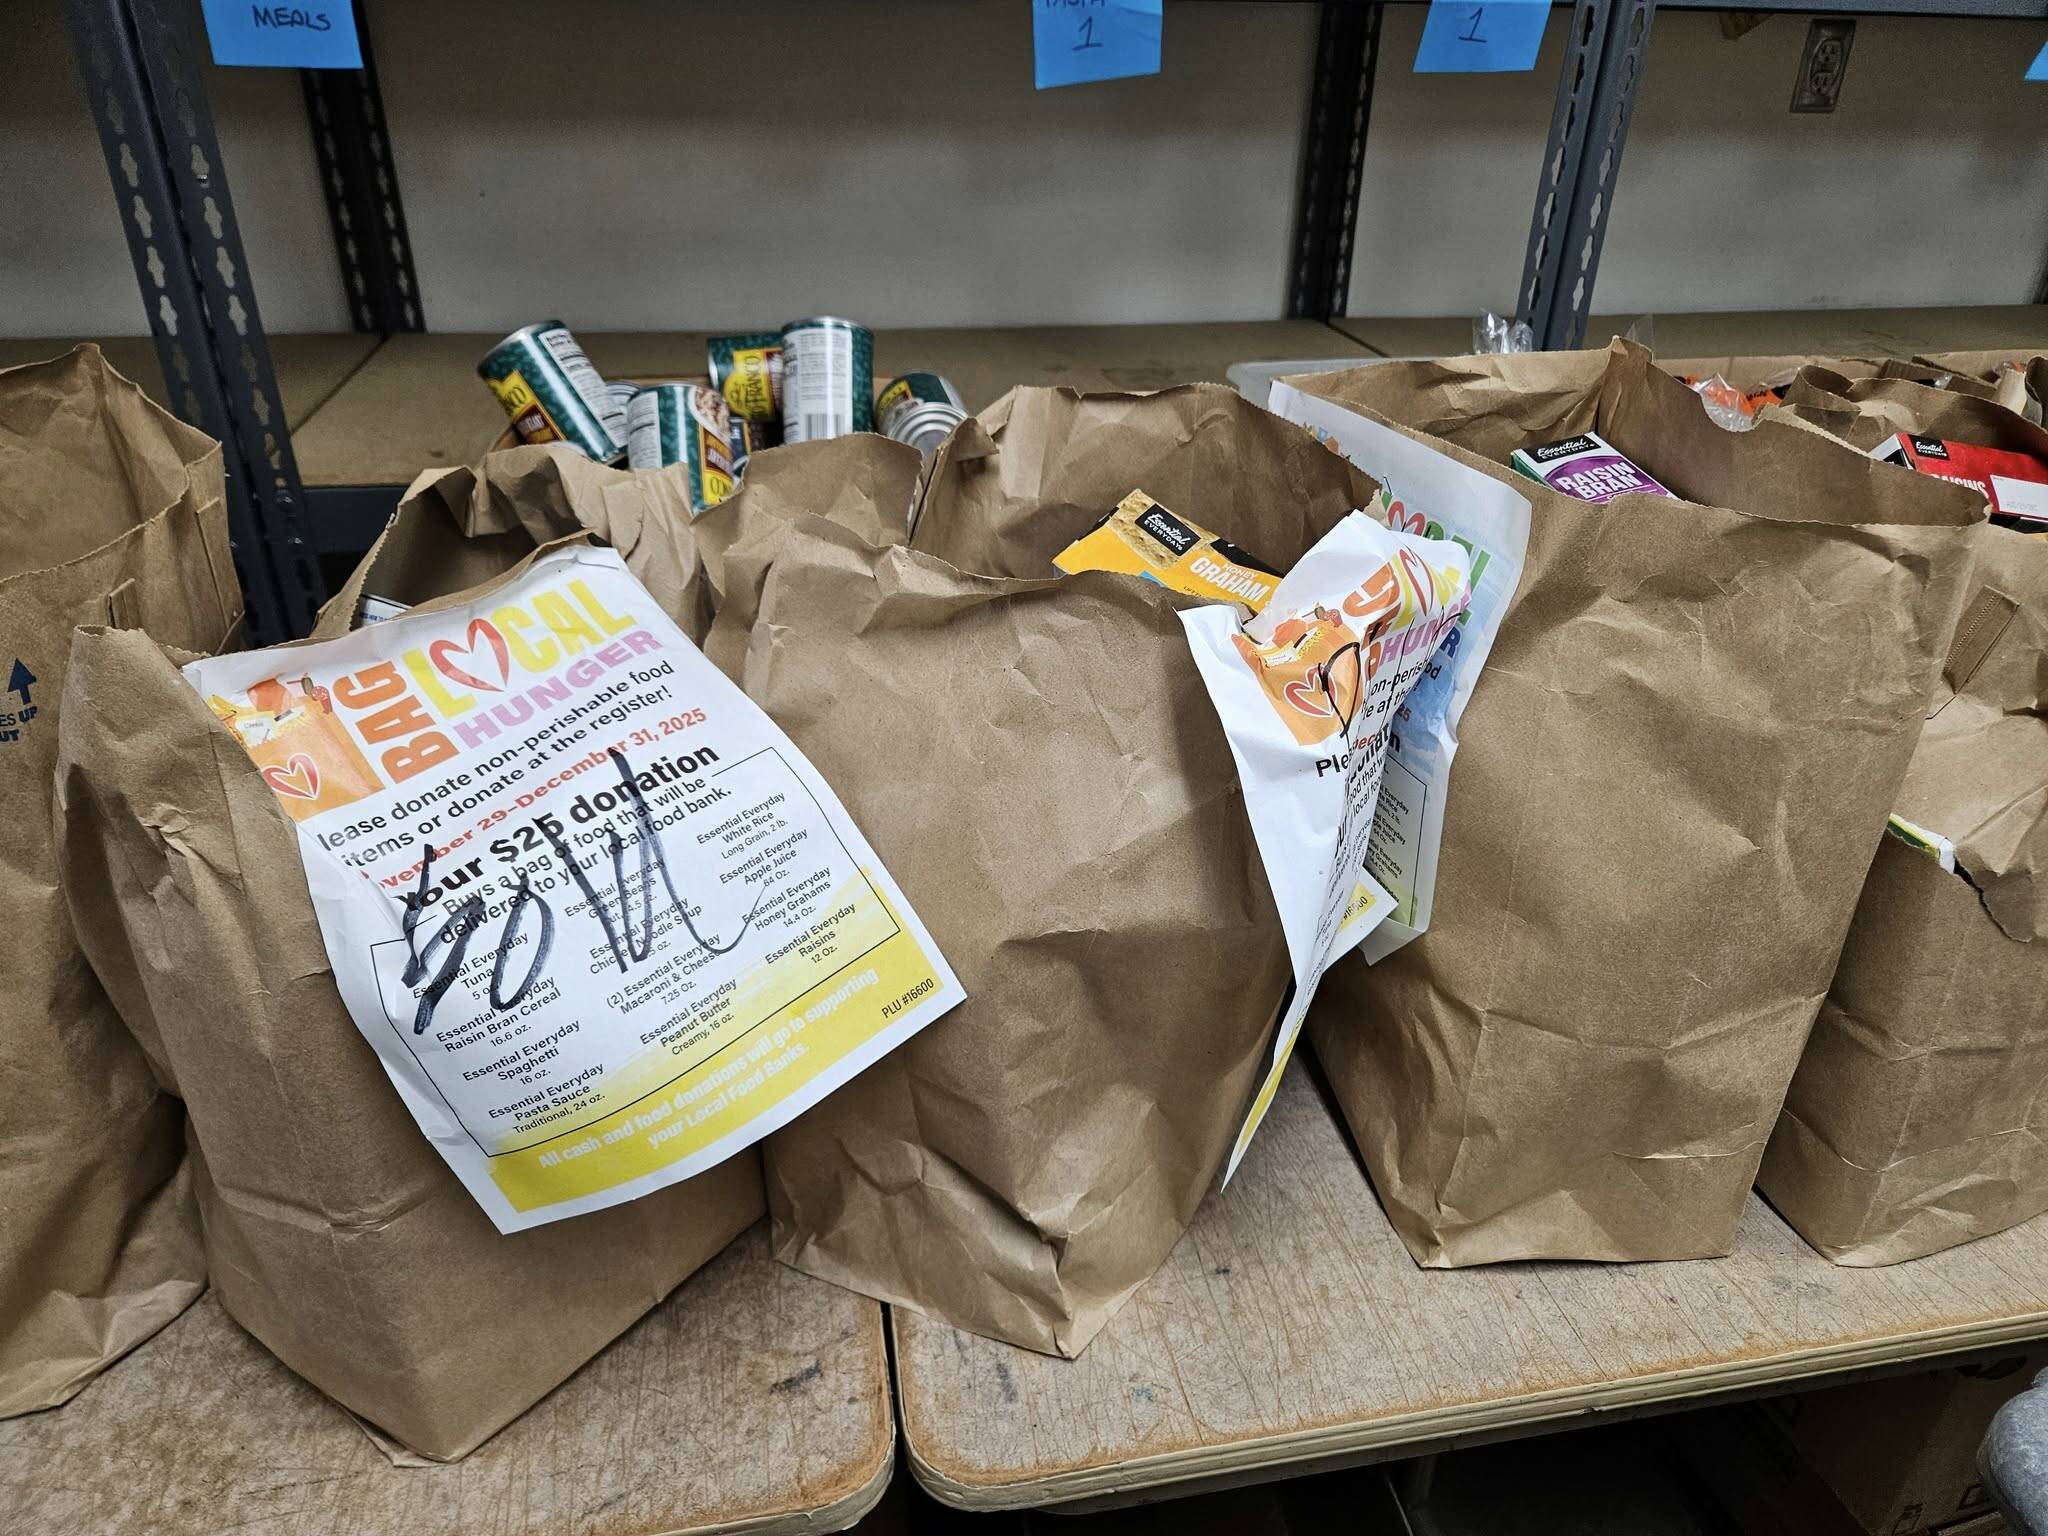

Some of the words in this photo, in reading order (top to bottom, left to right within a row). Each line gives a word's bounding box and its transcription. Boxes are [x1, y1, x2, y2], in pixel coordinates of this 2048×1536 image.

[252, 5, 331, 31] MEALS
[1072, 16, 1104, 51] 1
[1458, 7, 1487, 43] 1
[1537, 438, 1588, 457] Essential
[1915, 441, 1944, 453] Essential
[1555, 461, 1636, 491] RAISIN
[1575, 473, 1643, 499] BRAN
[1143, 519, 1183, 551] EVERYDAY
[1147, 513, 1192, 546] Essential
[1188, 557, 1272, 602] GRAHAM
[1221, 562, 1259, 580] HONEY
[453, 630, 663, 749] HUNGER
[18, 705, 37, 722] UP
[332, 660, 460, 784] BAG
[629, 728, 660, 746] 31,
[658, 707, 707, 736] 2025
[316, 815, 387, 851] lease
[391, 773, 472, 820] donate
[474, 680, 630, 777] non-perishable
[629, 660, 675, 685] food
[341, 832, 415, 867] items
[418, 815, 442, 835] or
[447, 769, 525, 818] donate
[527, 751, 551, 770] at
[551, 729, 587, 753] the
[589, 685, 673, 730] register!
[490, 812, 565, 863] $25
[569, 746, 720, 823] donation
[696, 814, 742, 844] Essential
[741, 791, 786, 820] Everyday
[442, 883, 495, 916] Buys
[498, 875, 510, 888] a
[511, 854, 552, 880] bag
[554, 839, 573, 859] of
[573, 818, 616, 848] food
[616, 800, 654, 825] that
[652, 784, 684, 807] will
[684, 777, 706, 793] be
[721, 823, 751, 844] White
[751, 811, 774, 827] Rice
[721, 843, 745, 860] Long
[744, 827, 771, 847] Grain,
[769, 823, 777, 832] 2
[776, 818, 789, 828] lb.
[440, 886, 532, 944] delivered
[534, 876, 555, 893] to
[557, 852, 598, 885] your
[600, 827, 646, 855] local
[646, 806, 685, 835] food
[684, 786, 732, 814] bank.
[719, 852, 764, 884] Essential
[764, 827, 809, 859] Everyday
[743, 863, 772, 885] Apple
[772, 849, 798, 868] Juice
[564, 883, 616, 918] Essential
[618, 858, 665, 888] veryday
[741, 890, 786, 924] Essential
[785, 866, 832, 898] Everyday
[763, 876, 775, 887] 64
[775, 869, 791, 880] Oz.
[589, 895, 622, 919] Geen
[640, 898, 689, 928] Eeryday
[674, 905, 702, 925] Soup
[753, 908, 787, 931] Honey
[786, 880, 832, 911] Grahams
[782, 914, 801, 928] 14.4
[801, 906, 817, 918] Oz.
[471, 932, 529, 969] Everyday
[764, 931, 810, 965] Essential
[809, 902, 857, 935] Everyday
[798, 930, 837, 958] Raisins
[606, 991, 624, 1008] (2)
[623, 960, 674, 996] Essential
[673, 933, 721, 966] Everyday
[810, 954, 823, 964] 12
[821, 945, 838, 958] Oz.
[461, 968, 495, 990] Tuna
[472, 991, 481, 1001] 5
[619, 977, 671, 1015] Macaroni
[671, 972, 682, 983] &
[682, 951, 721, 976] Cheese
[660, 989, 681, 1006] 7.25
[681, 981, 697, 992] Oz.
[881, 1003, 902, 1019] PLU
[901, 978, 935, 1006] #16600
[435, 1007, 497, 1043] Essential
[500, 976, 555, 1013] ryday
[444, 1031, 486, 1053] Raisin
[486, 1013, 519, 1034] Bran
[520, 987, 561, 1016] Cereal
[639, 1007, 690, 1045] Essential
[690, 978, 737, 1013] Everyday
[659, 1017, 700, 1048] Peanut
[699, 997, 731, 1022] Butter
[462, 1052, 521, 1081] Essential
[522, 1020, 581, 1057] Everyday
[489, 1031, 513, 1048] 16.6
[514, 1025, 532, 1036] oz.
[671, 1028, 710, 1056] Creamy,
[709, 1019, 721, 1031] 16
[721, 1013, 735, 1024] oz.
[497, 1046, 560, 1081] Spaghetti
[519, 1076, 533, 1086] 16
[534, 1070, 551, 1080] oz.
[538, 1150, 560, 1169] All
[562, 1135, 601, 1161] cash
[603, 1121, 634, 1146] and
[633, 1101, 673, 1130] food
[673, 1056, 748, 1110] donations
[747, 1035, 773, 1067] will
[772, 1027, 792, 1049] go
[789, 1017, 806, 1033] to
[805, 967, 880, 1024] supporting
[488, 1090, 546, 1119] Essential
[546, 1063, 605, 1097] Everyday
[514, 1101, 550, 1122] Pasta
[551, 1085, 591, 1107] Sauce
[648, 1120, 686, 1150] your
[686, 1093, 728, 1127] Local
[728, 1067, 765, 1101] Food
[763, 1041, 810, 1078] Banks.
[513, 1107, 573, 1134] Traditional,
[573, 1100, 588, 1111] 24
[589, 1094, 606, 1104] oz.
